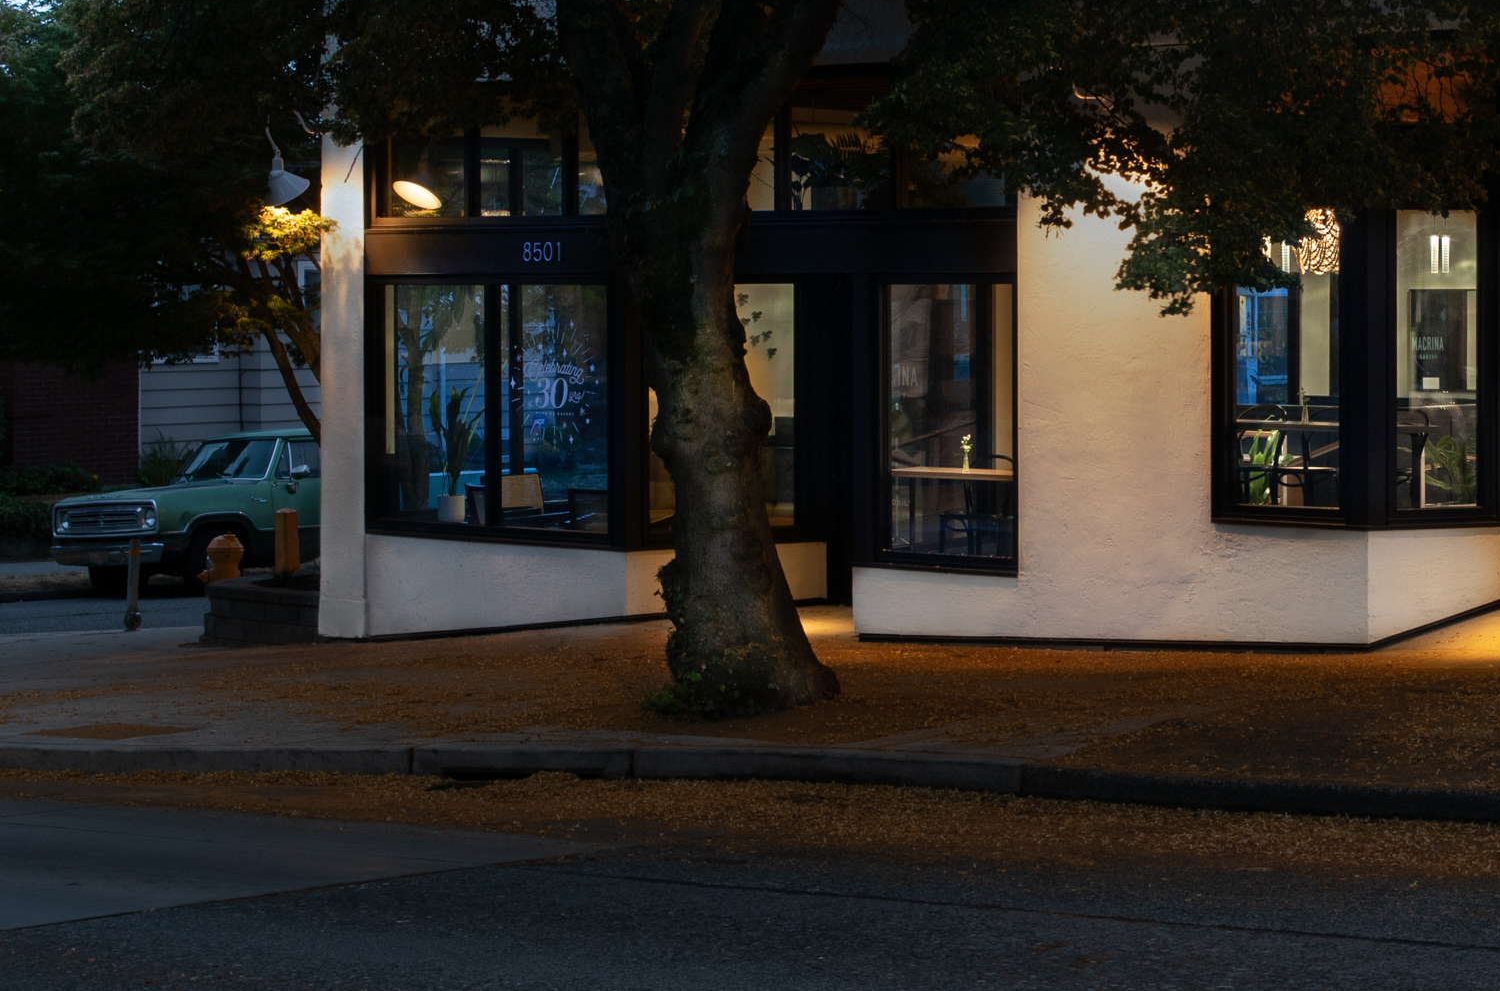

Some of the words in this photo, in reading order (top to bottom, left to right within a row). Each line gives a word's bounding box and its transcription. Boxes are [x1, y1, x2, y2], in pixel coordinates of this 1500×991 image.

[522, 241, 561, 262] 8501
[1411, 336, 1445, 351] MACRINA
[523, 358, 585, 385] Celebrating
[534, 377, 569, 409] 30
